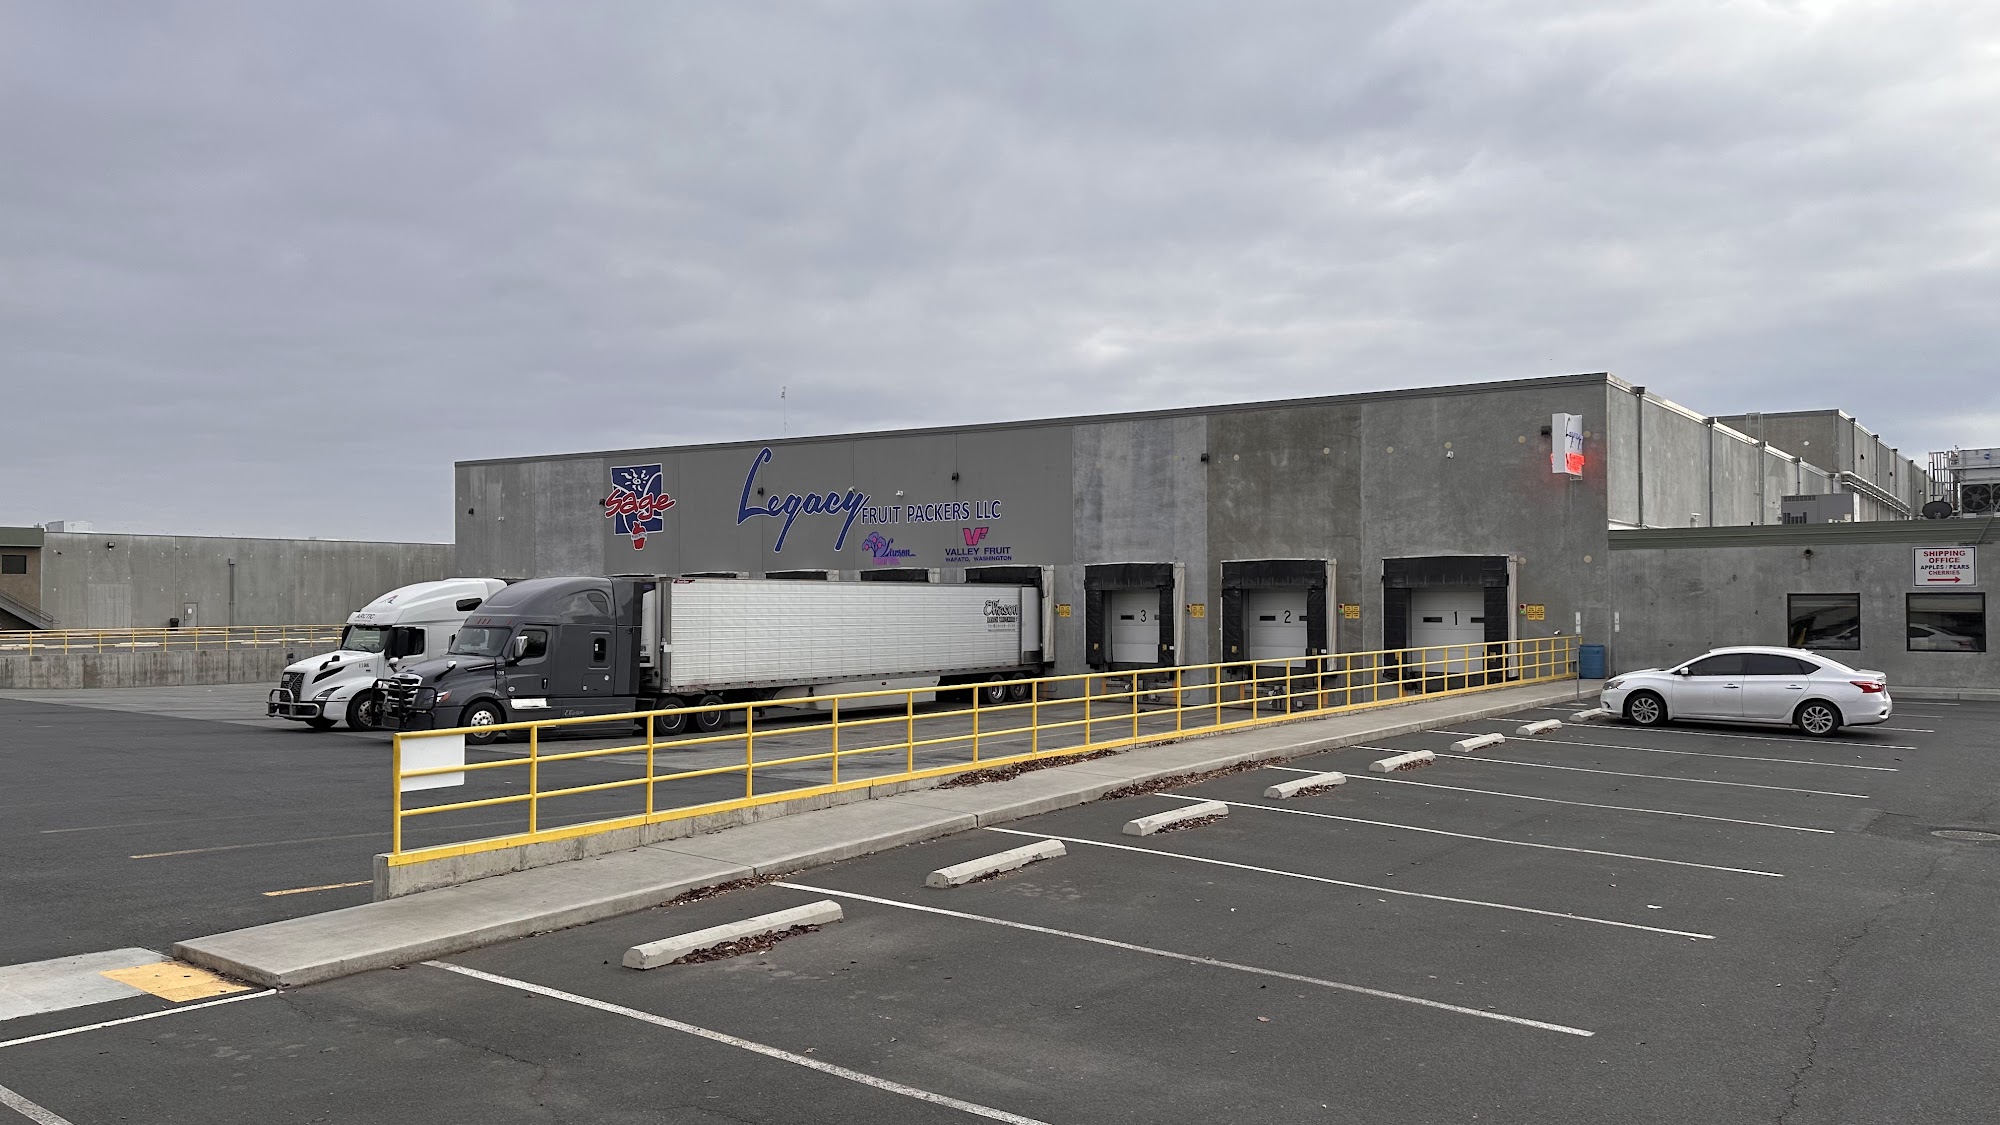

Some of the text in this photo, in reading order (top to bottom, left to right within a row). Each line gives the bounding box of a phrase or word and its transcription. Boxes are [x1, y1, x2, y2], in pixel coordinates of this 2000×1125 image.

[737, 447, 1002, 553] Legacy FRUIT PACKERS LLC
[945, 546, 1012, 556] VALLEY FRUIT
[1140, 609, 1147, 622] 3
[1284, 610, 1292, 624] 2
[1453, 610, 1458, 626] 1
